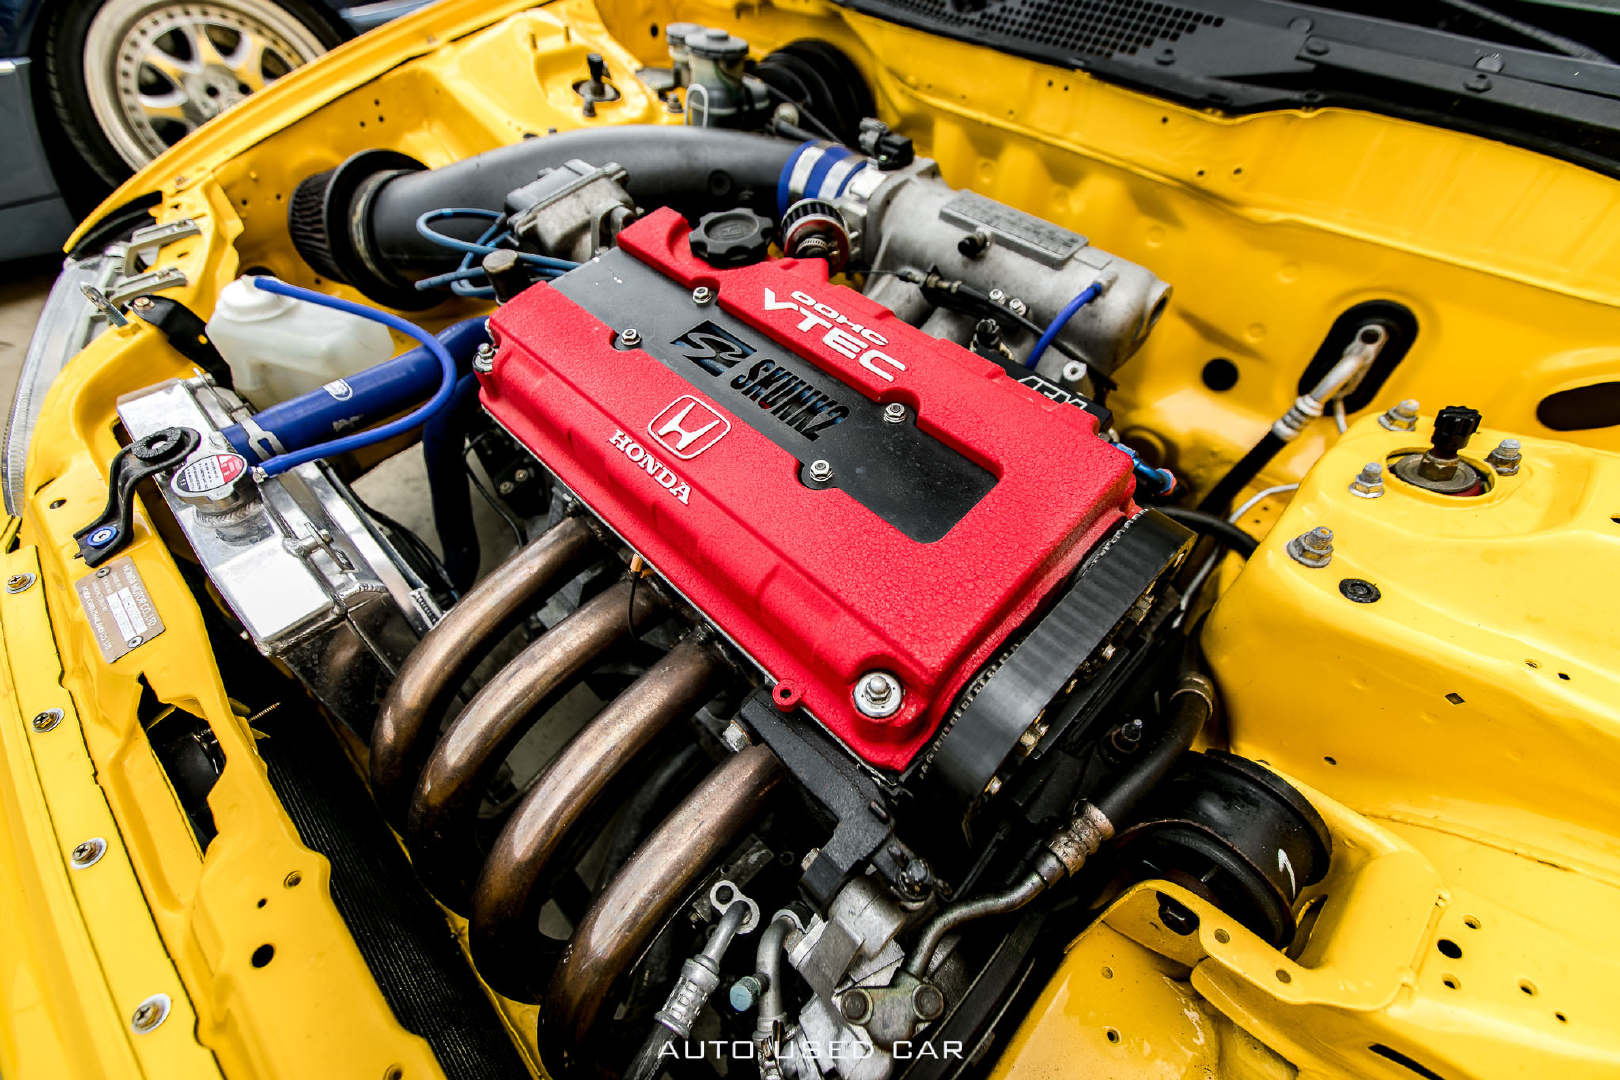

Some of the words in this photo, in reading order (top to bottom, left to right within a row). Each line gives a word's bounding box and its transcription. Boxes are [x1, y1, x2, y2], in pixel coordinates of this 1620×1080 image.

[764, 287, 907, 383] VTEC
[791, 290, 889, 347] DOHC
[730, 358, 850, 442] SKUNK2
[608, 429, 692, 505] HONDA
